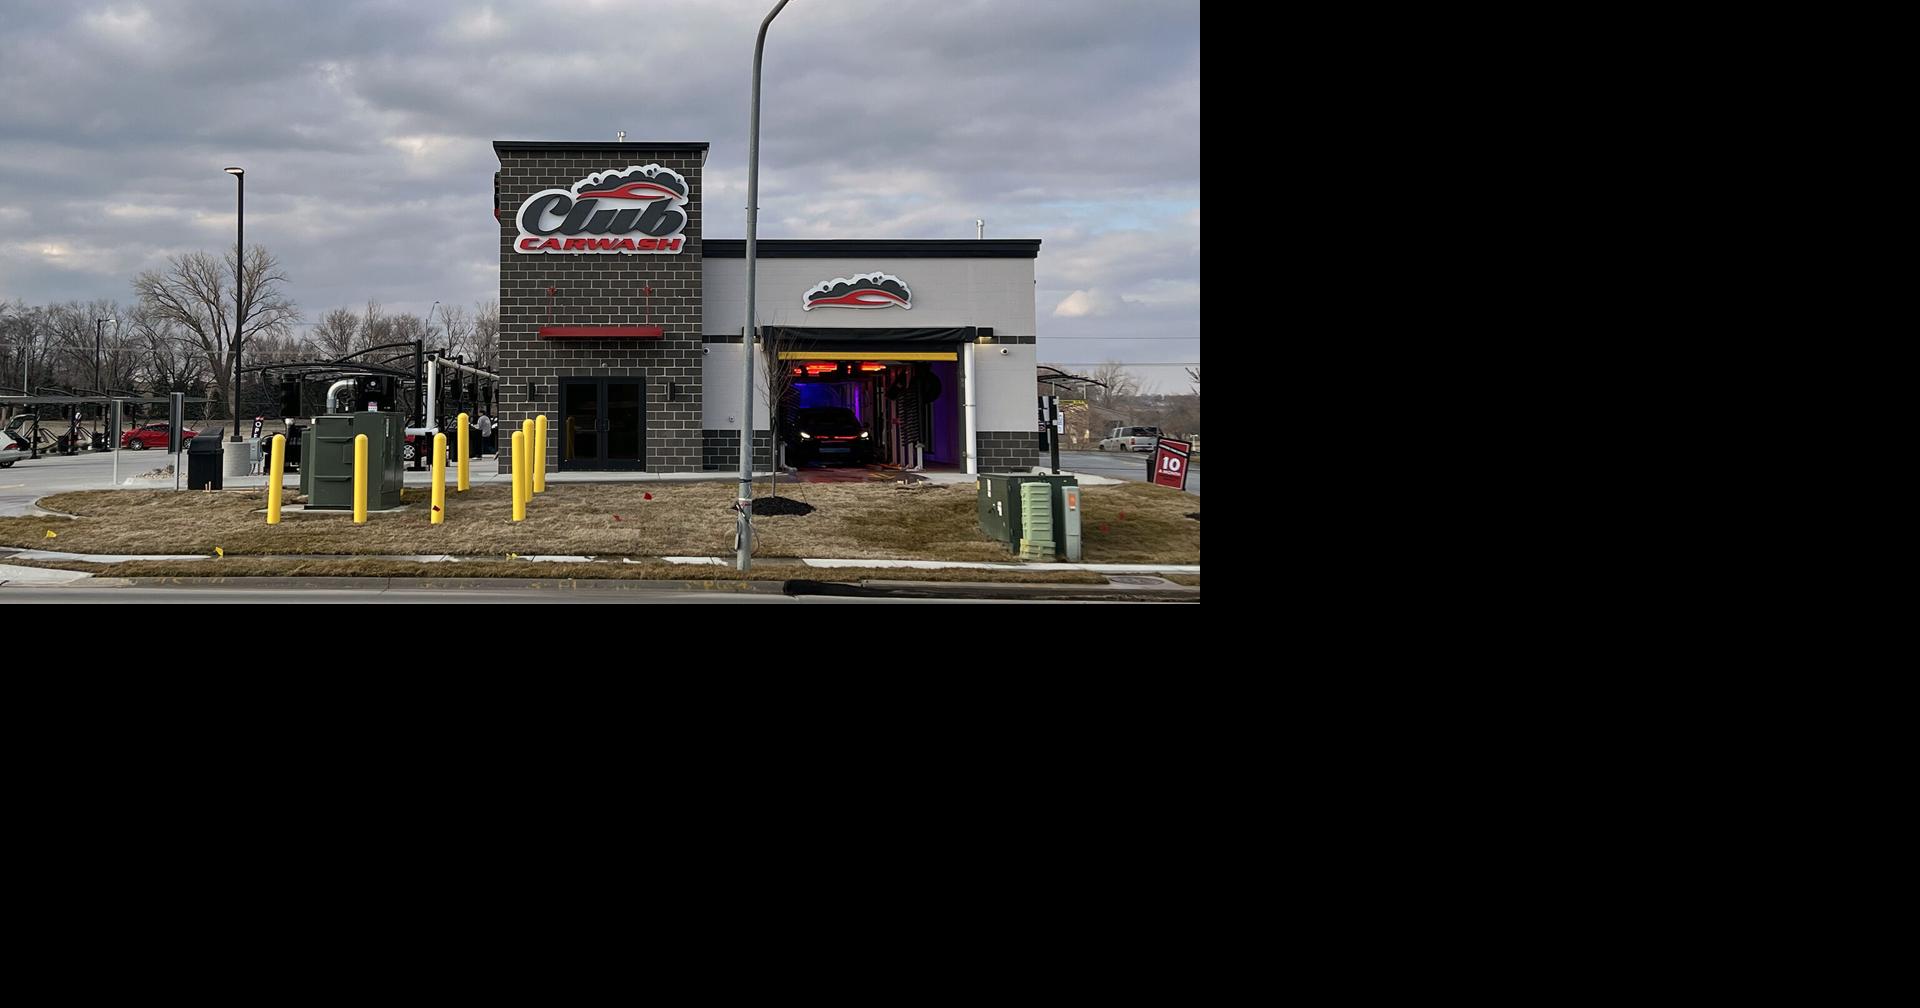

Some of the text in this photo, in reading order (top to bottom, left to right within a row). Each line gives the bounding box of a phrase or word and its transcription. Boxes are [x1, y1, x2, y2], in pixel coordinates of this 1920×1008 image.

[522, 193, 684, 236] Club
[519, 238, 682, 251] CARWASH
[1162, 456, 1180, 471] 10
